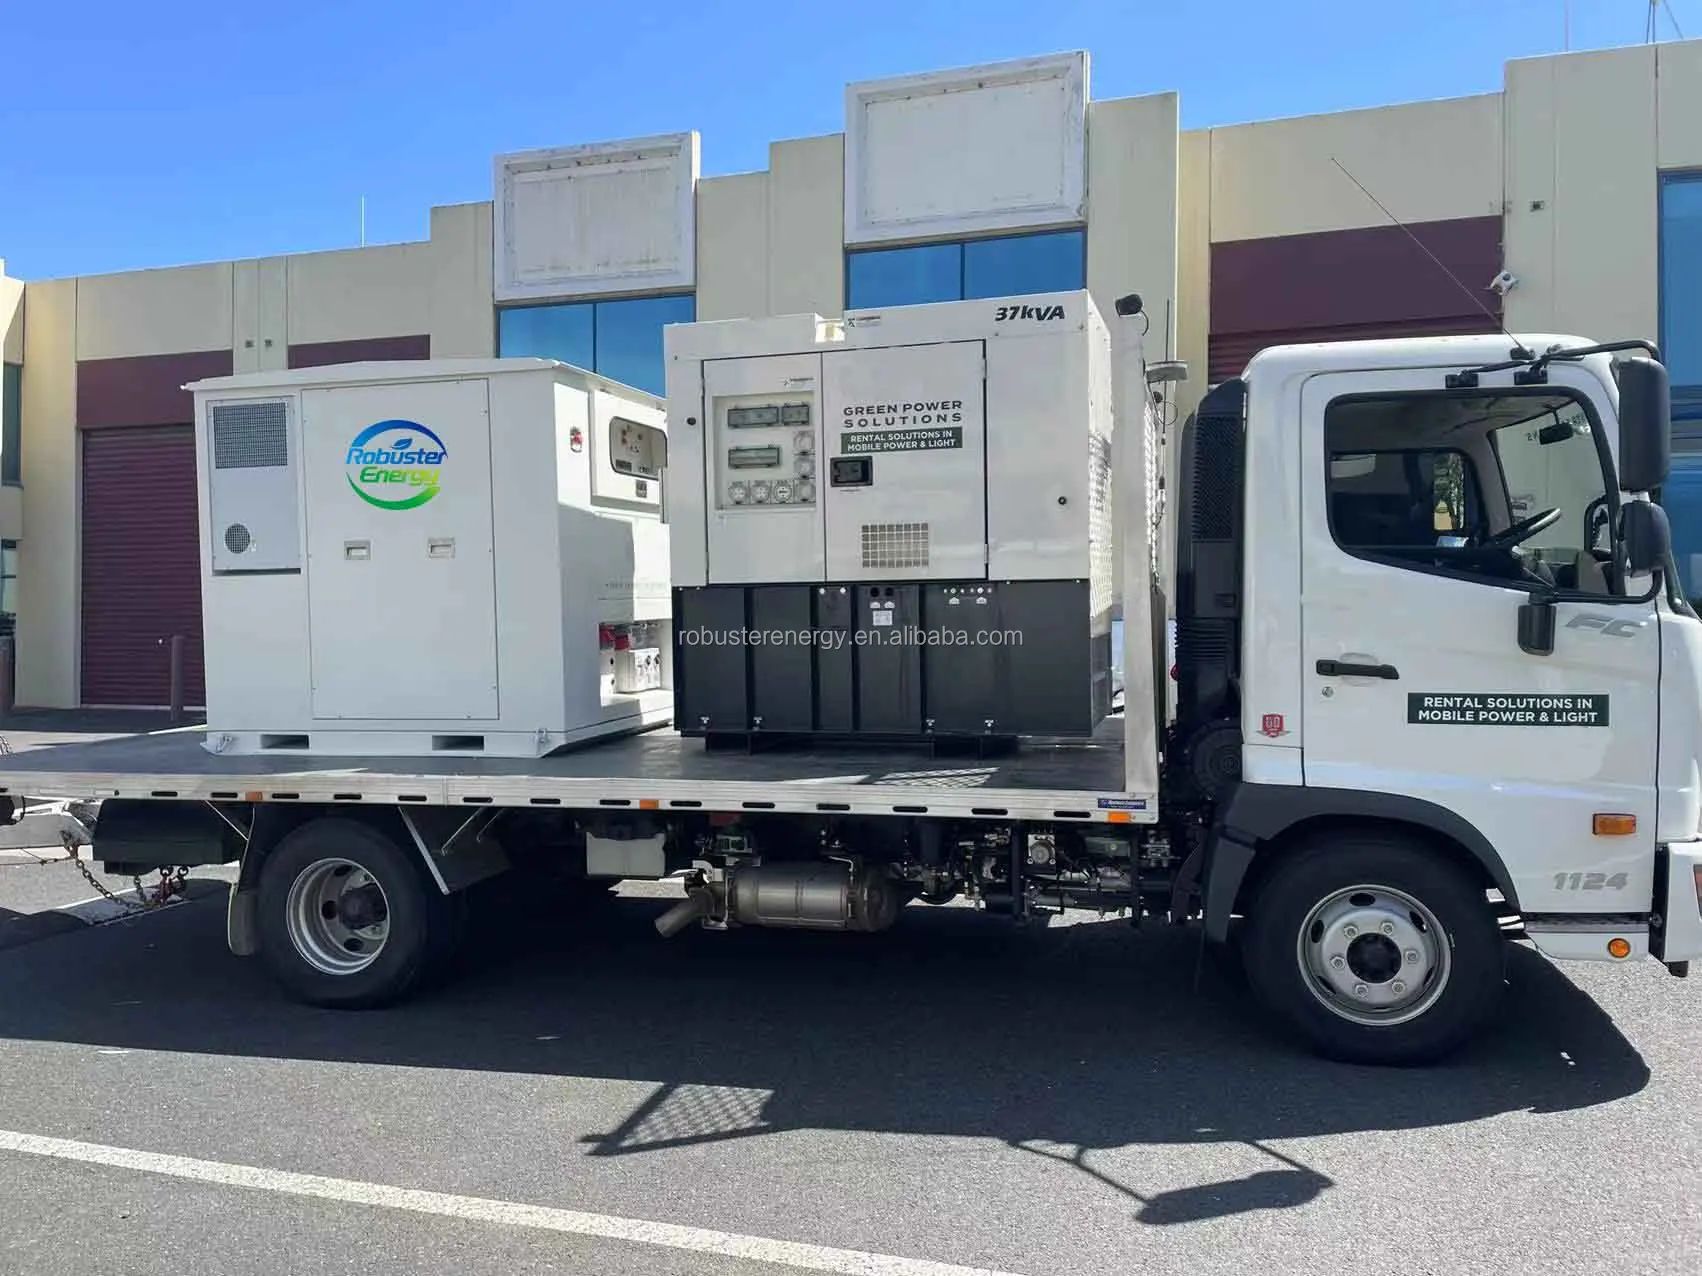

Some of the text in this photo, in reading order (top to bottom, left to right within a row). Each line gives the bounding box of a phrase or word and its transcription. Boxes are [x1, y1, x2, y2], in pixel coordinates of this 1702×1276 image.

[994, 304, 1065, 322] 37kVA
[843, 400, 963, 416] GREEN POWER
[843, 412, 962, 428] SOLUTIONS
[850, 430, 953, 443] RENTAL SOLUTIONS IN
[847, 438, 956, 452] MOBILE POWER & LIGHT
[345, 447, 446, 465] Robuster
[359, 466, 441, 487] Energy
[1423, 696, 1593, 709] RENTAL SOLUTIONS IN
[1418, 709, 1599, 723] MOBILE POWER & LIGHT
[1553, 872, 1629, 890] 1124
